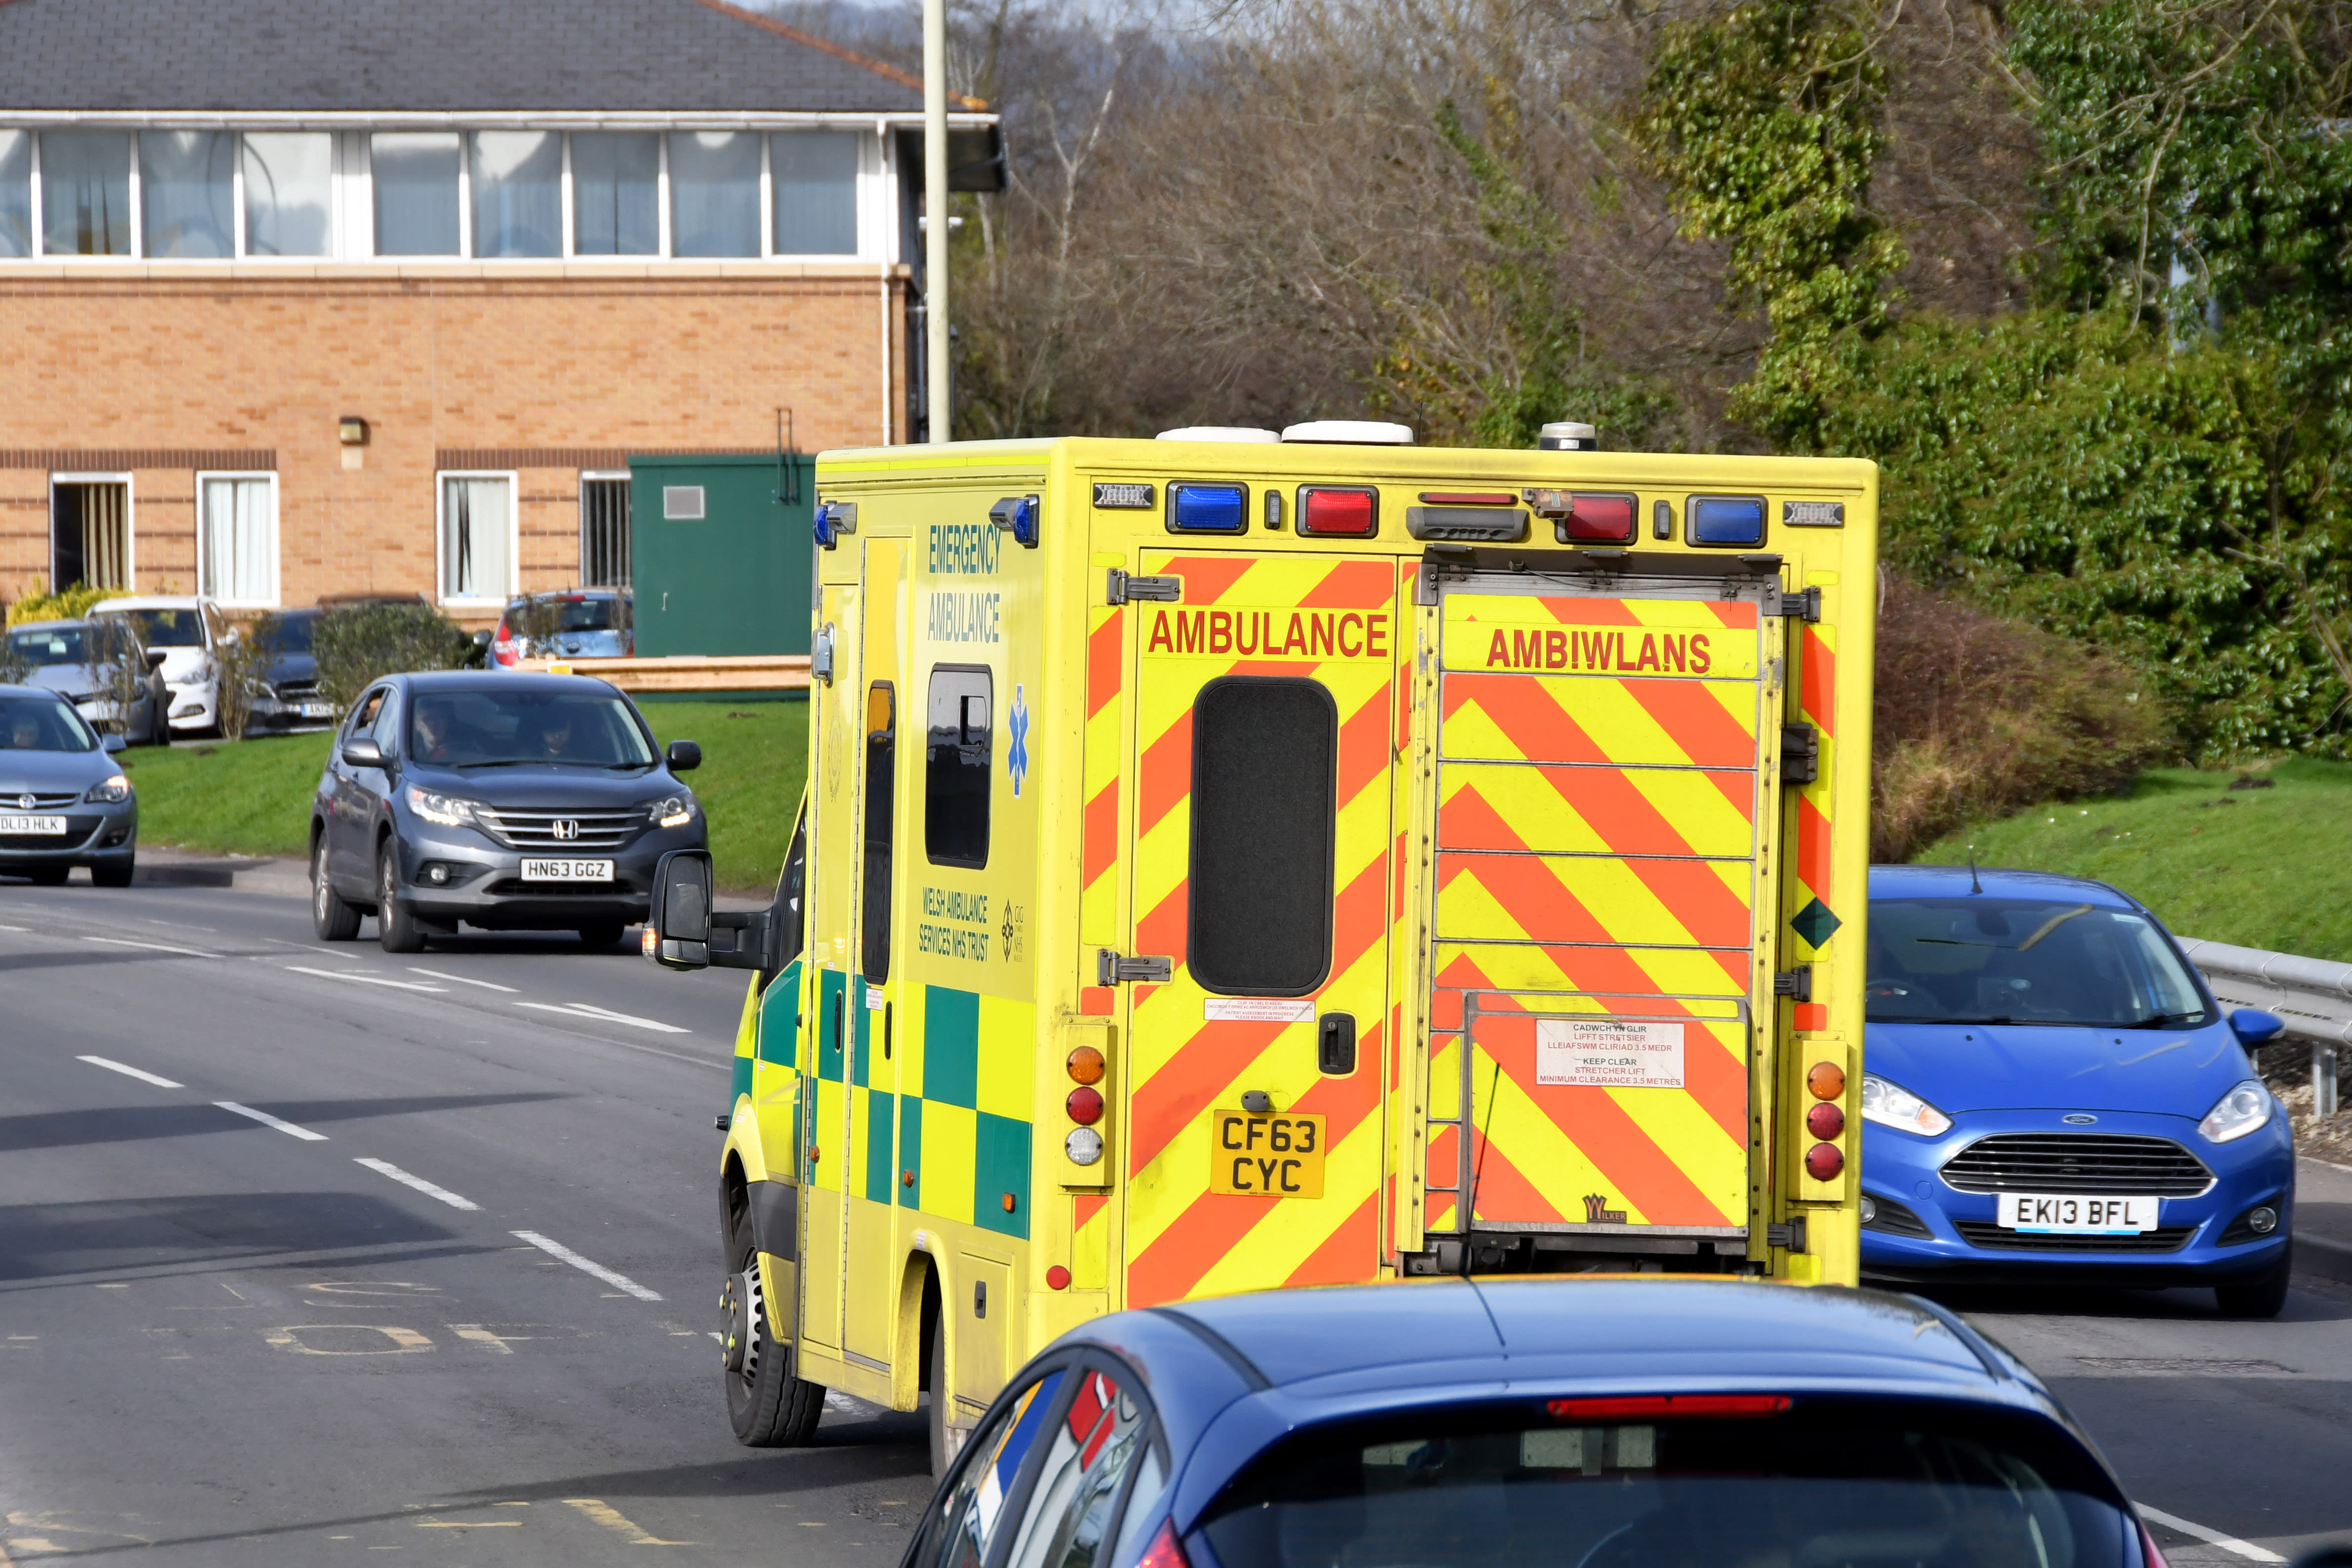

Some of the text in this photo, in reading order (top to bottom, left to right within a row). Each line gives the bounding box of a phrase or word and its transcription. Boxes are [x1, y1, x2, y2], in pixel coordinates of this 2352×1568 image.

[929, 523, 1002, 574] EMERGENCY
[927, 593, 1000, 643] AMBULANCE
[1148, 610, 1387, 657] AMBULANCE
[1486, 629, 1711, 674] AMBIWLANS
[1, 818, 58, 830] DL13 HLK
[528, 861, 605, 877] HN63 GGZ
[923, 887, 988, 924] WELSH AMBULANCE
[919, 923, 989, 962] SERVICES NHS TRUST
[1013, 936, 1023, 954] NHS
[1579, 1076, 1631, 1084] CLEARANCE
[1222, 1117, 1316, 1153] CF63
[1232, 1157, 1302, 1192] CYC
[1585, 1198, 1626, 1220] WILKER
[2017, 1198, 2139, 1226] EK13 BFL
